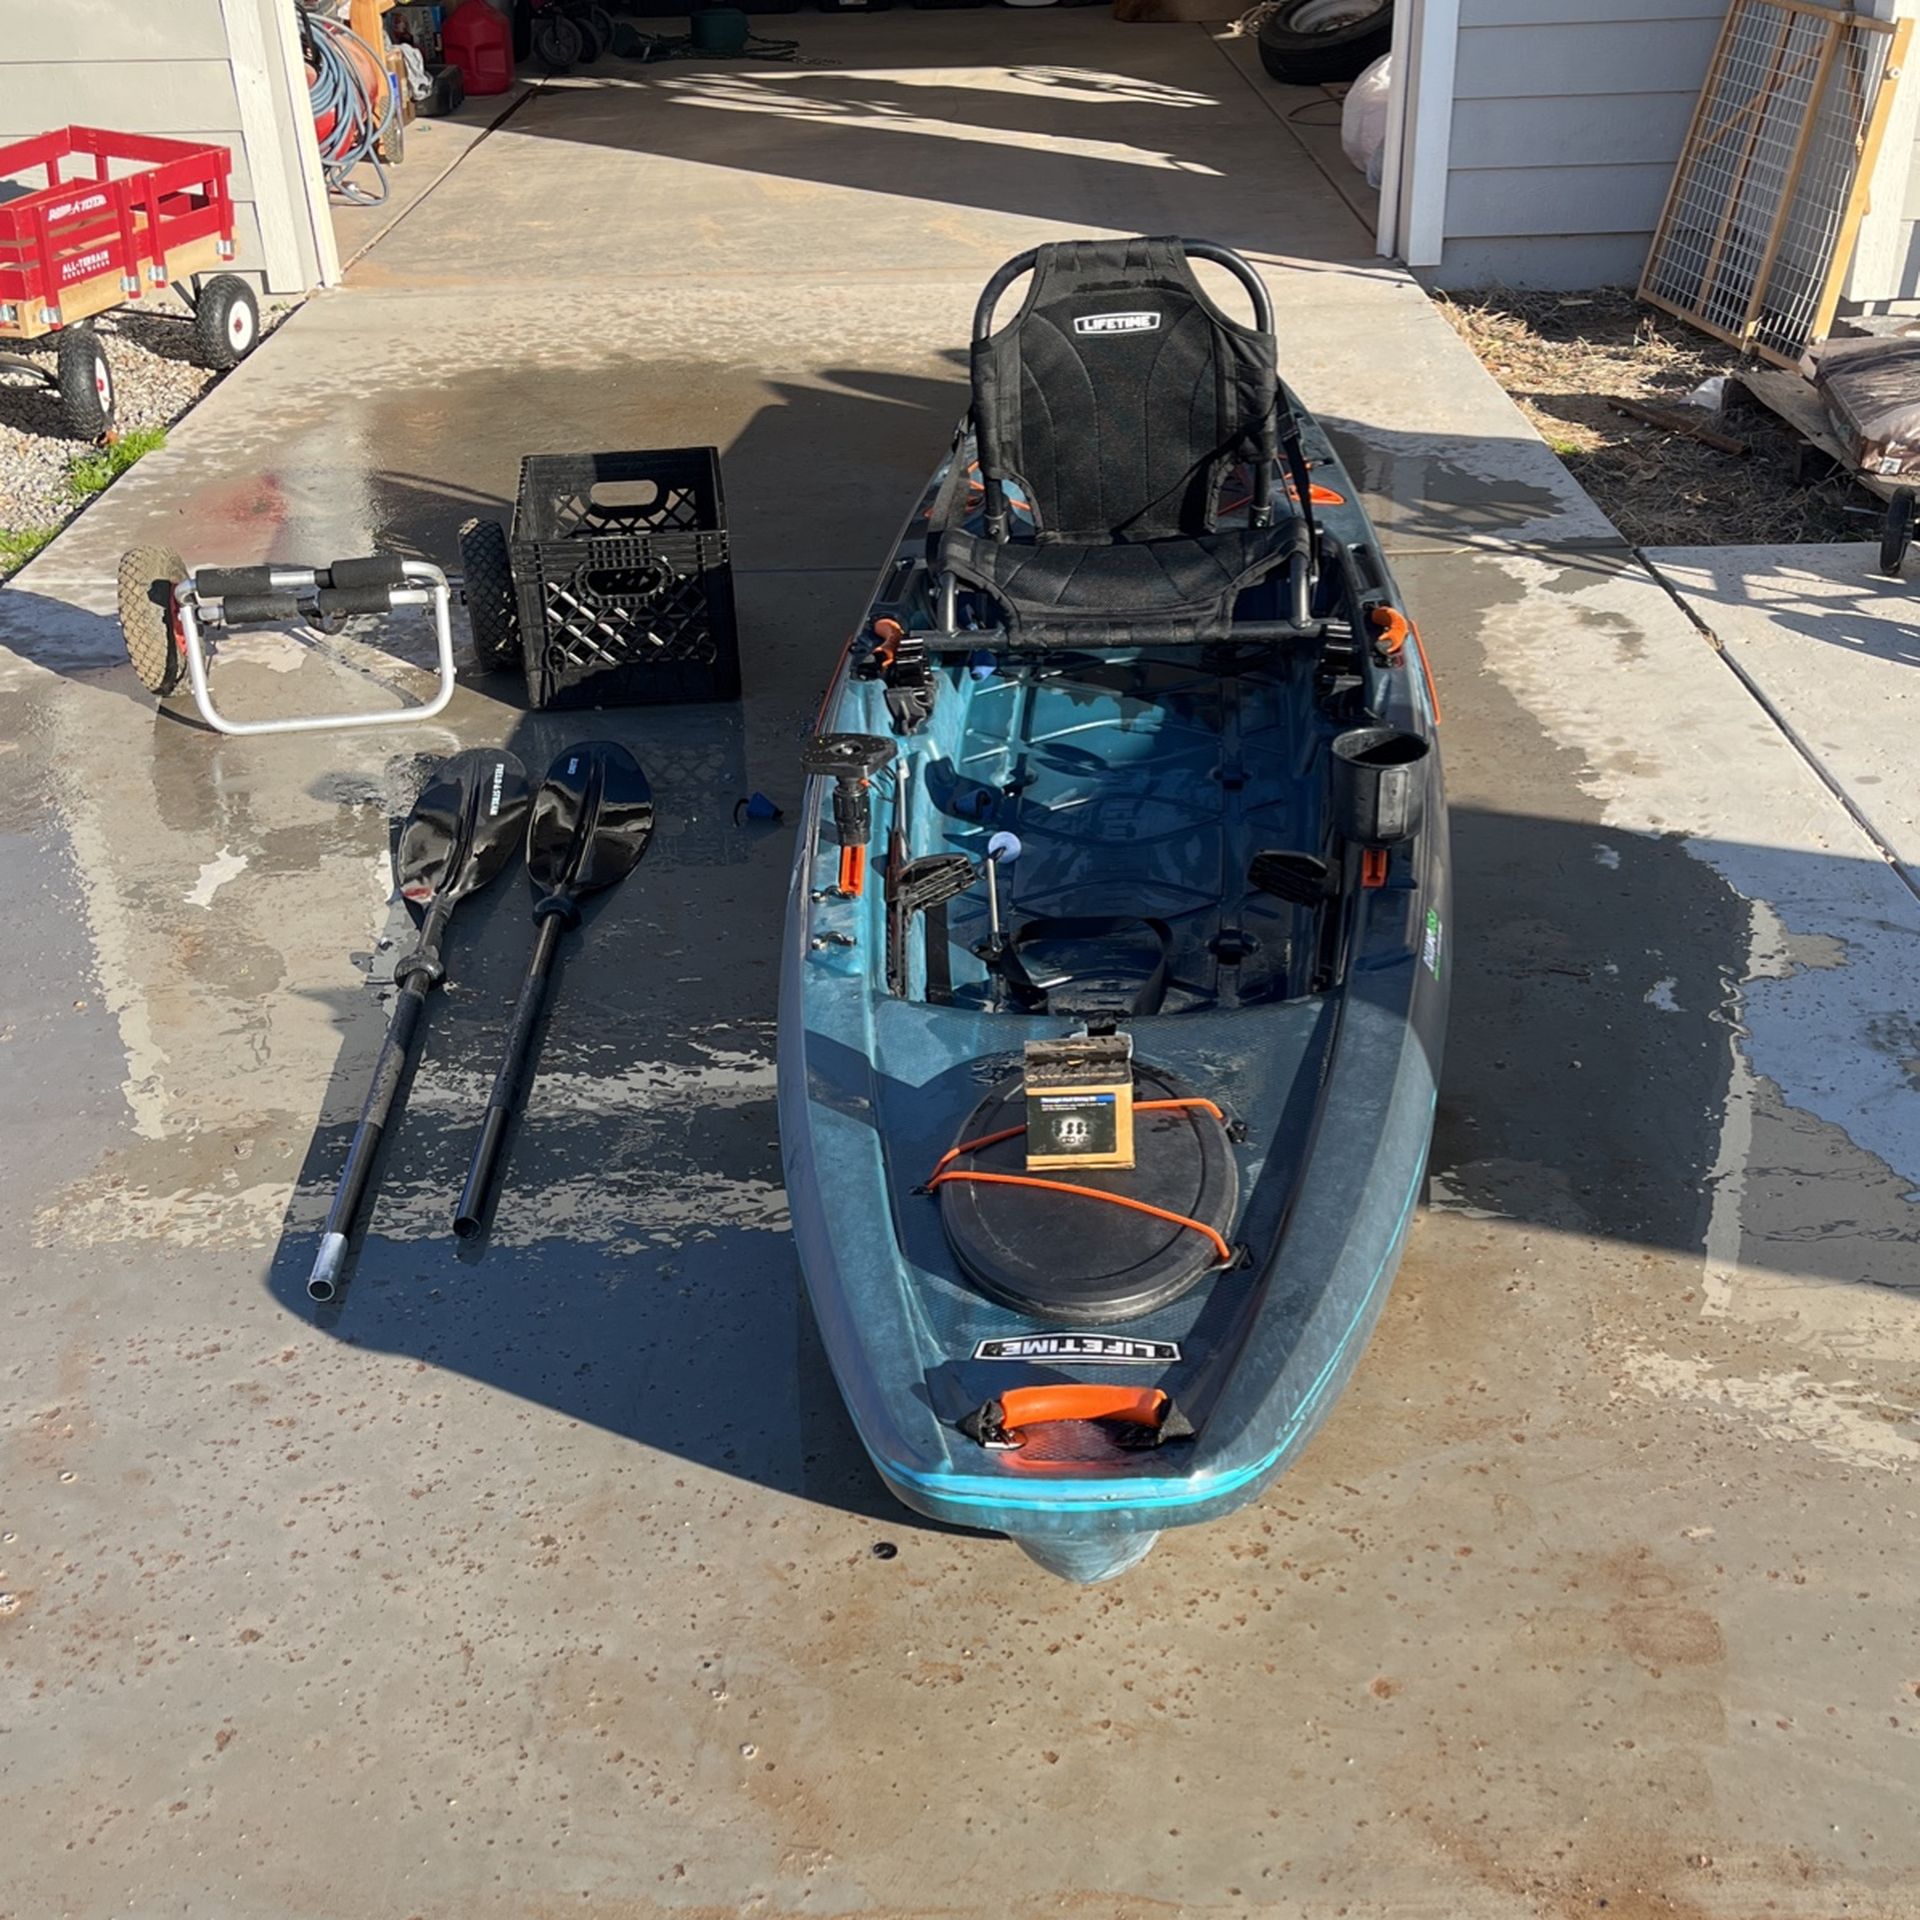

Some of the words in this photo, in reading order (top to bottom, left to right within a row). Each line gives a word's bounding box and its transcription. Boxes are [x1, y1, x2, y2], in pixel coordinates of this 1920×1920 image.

[62, 249, 109, 274] ALL-TERRAIN
[1084, 316, 1151, 330] LIFETIME
[1001, 1338, 1156, 1358] LIFETIME
